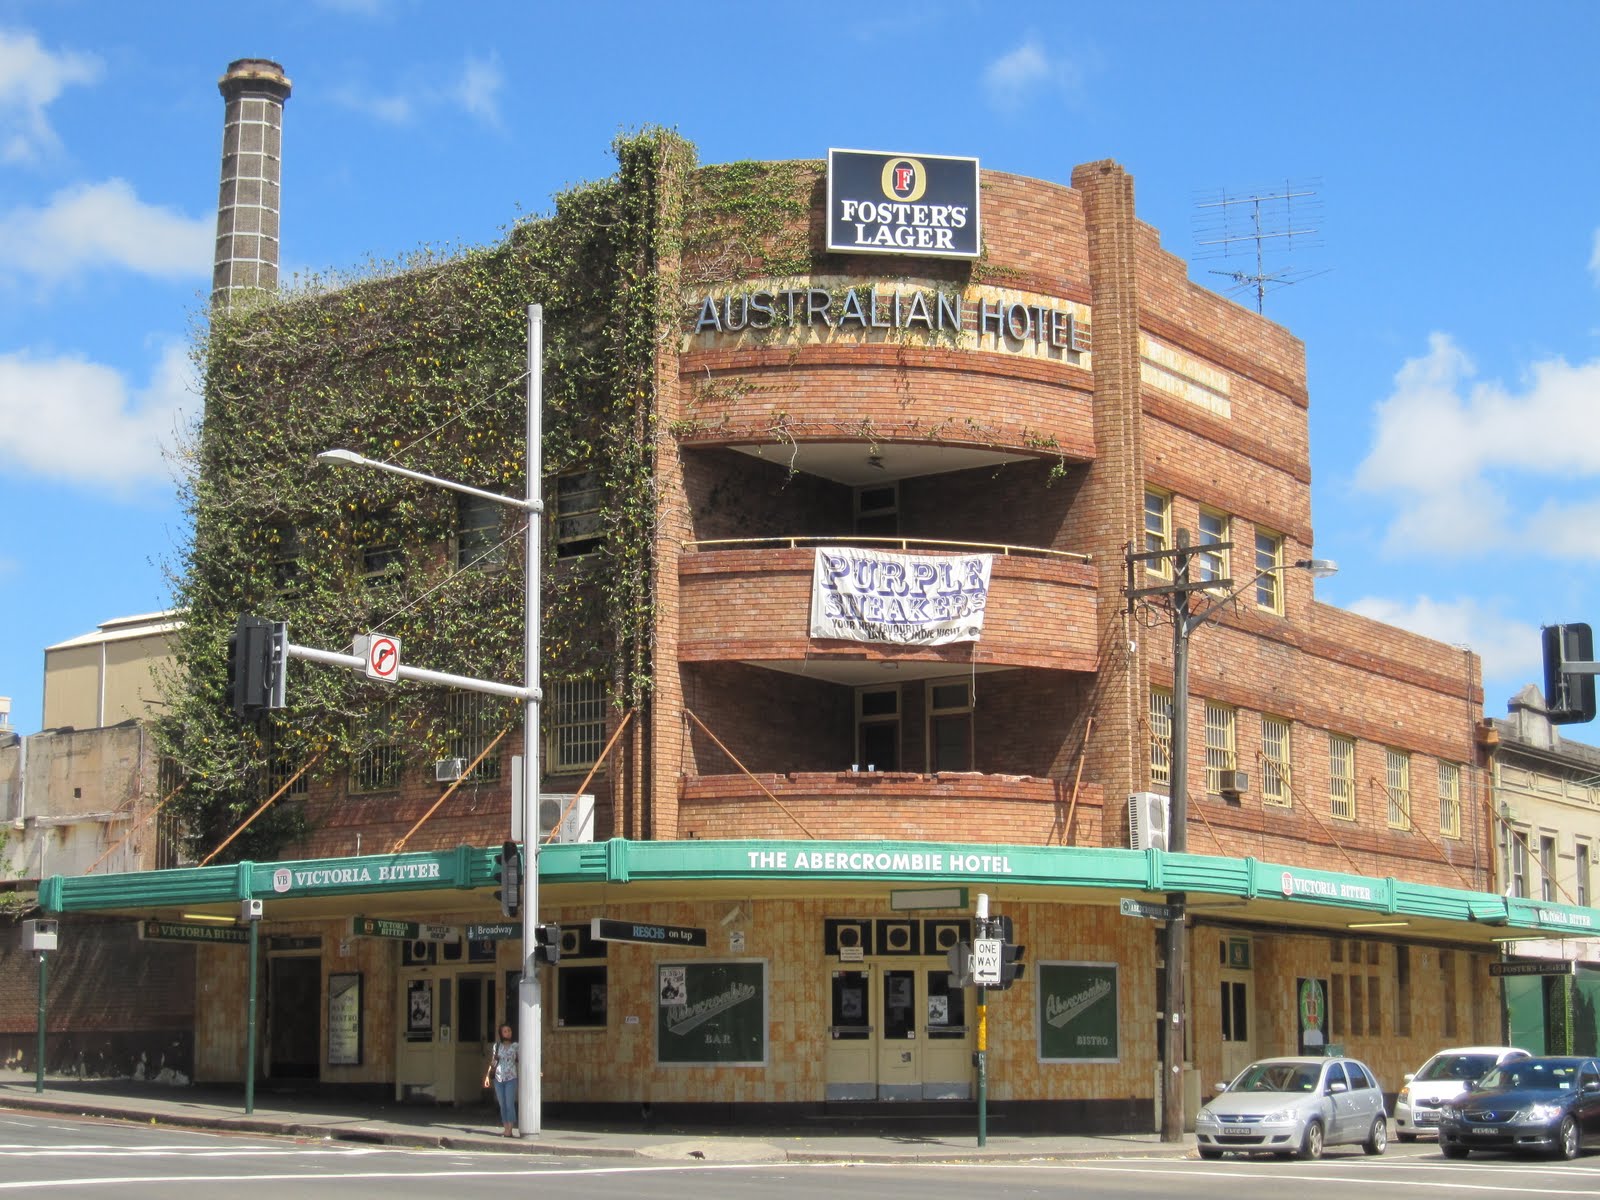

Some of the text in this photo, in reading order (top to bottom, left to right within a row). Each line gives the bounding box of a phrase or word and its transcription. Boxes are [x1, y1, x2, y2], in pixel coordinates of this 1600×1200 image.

[841, 200, 967, 228] FOSTER'S
[855, 224, 955, 249] LAGER
[695, 288, 1091, 353] AUSTRALIAN HOTEL
[821, 555, 986, 597] PURPLE
[825, 591, 985, 624] SNEAKERS
[832, 619, 855, 631] YOUR
[748, 851, 1012, 873] THE ABERCROMBIE HOTEL
[277, 863, 440, 886] VB VICTORIA BITTER
[1293, 878, 1337, 896] VICTORIA
[1340, 884, 1371, 900] BITTER
[161, 926, 212, 939] VICTORIA
[378, 920, 409, 931] VICTORIA
[478, 925, 513, 937] Broadway
[633, 925, 692, 941] RESCHS on tap
[979, 943, 997, 954] ONE
[978, 956, 998, 966] WAY
[705, 1034, 732, 1044] BAR
[1077, 1035, 1108, 1045] BISTRO
